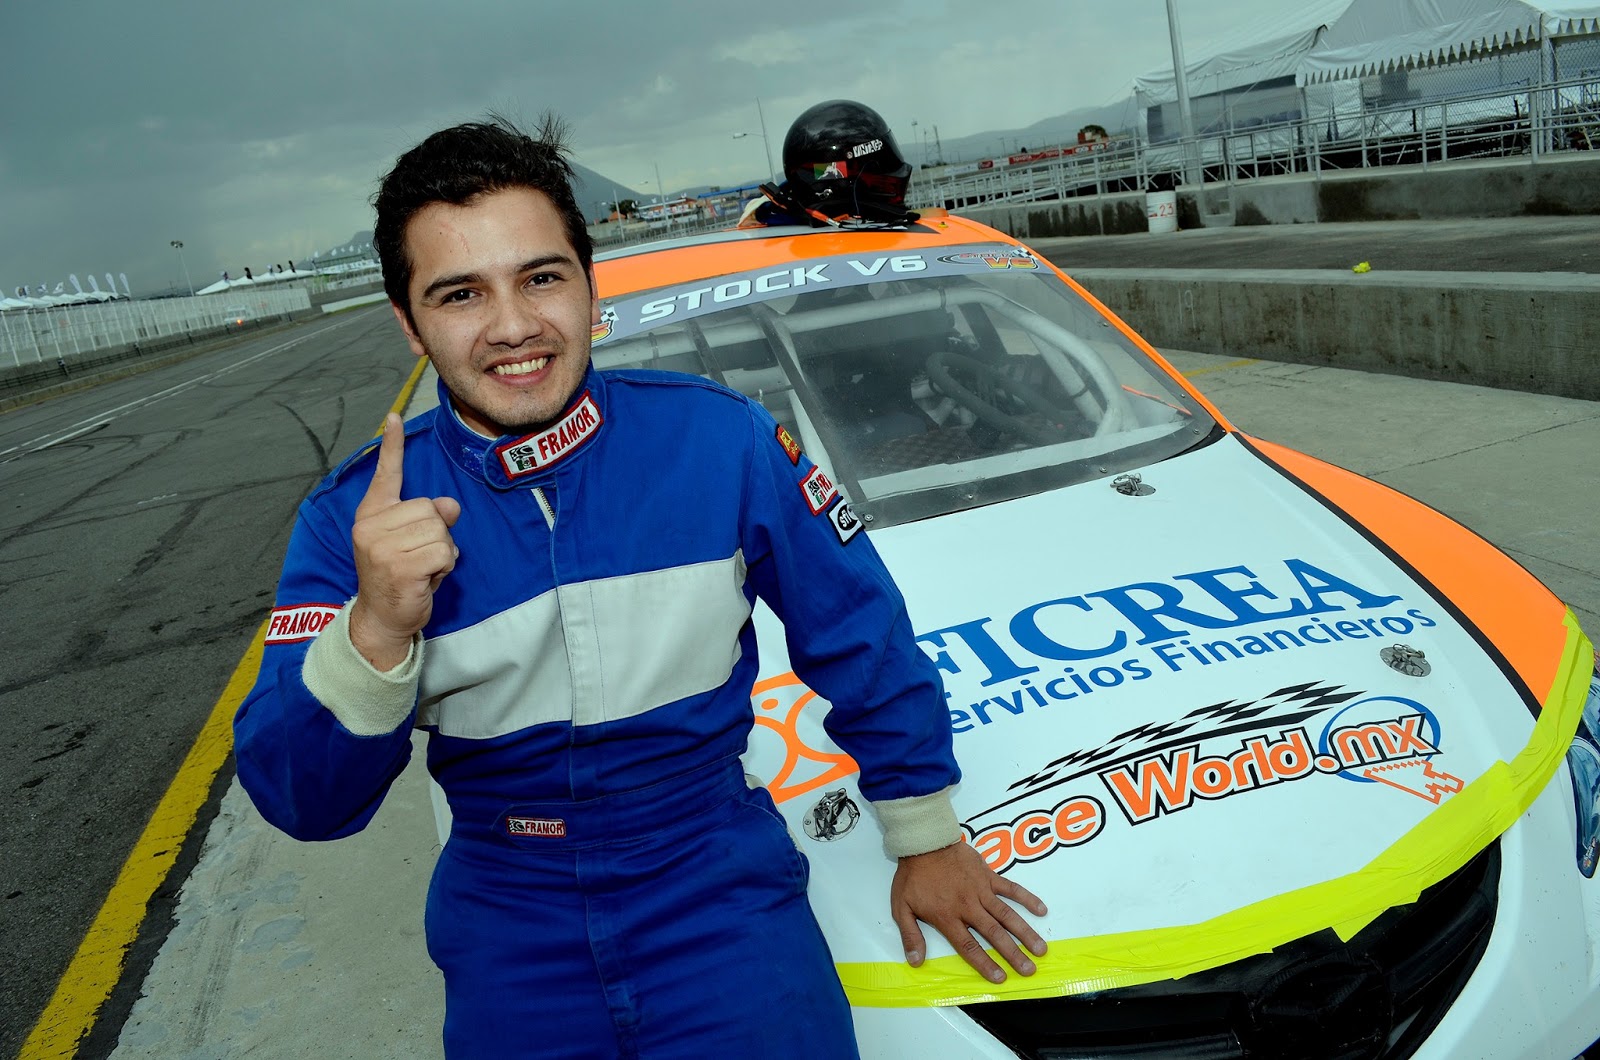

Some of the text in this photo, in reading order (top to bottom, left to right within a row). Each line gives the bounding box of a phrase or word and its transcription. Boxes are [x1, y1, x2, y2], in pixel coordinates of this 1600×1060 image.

[639, 254, 928, 324] STOCK V6
[537, 405, 597, 461] FRAMOR
[945, 609, 1437, 734] ervicios Financieros
[525, 821, 564, 834] FRAMOR
[960, 795, 1106, 875] ace
